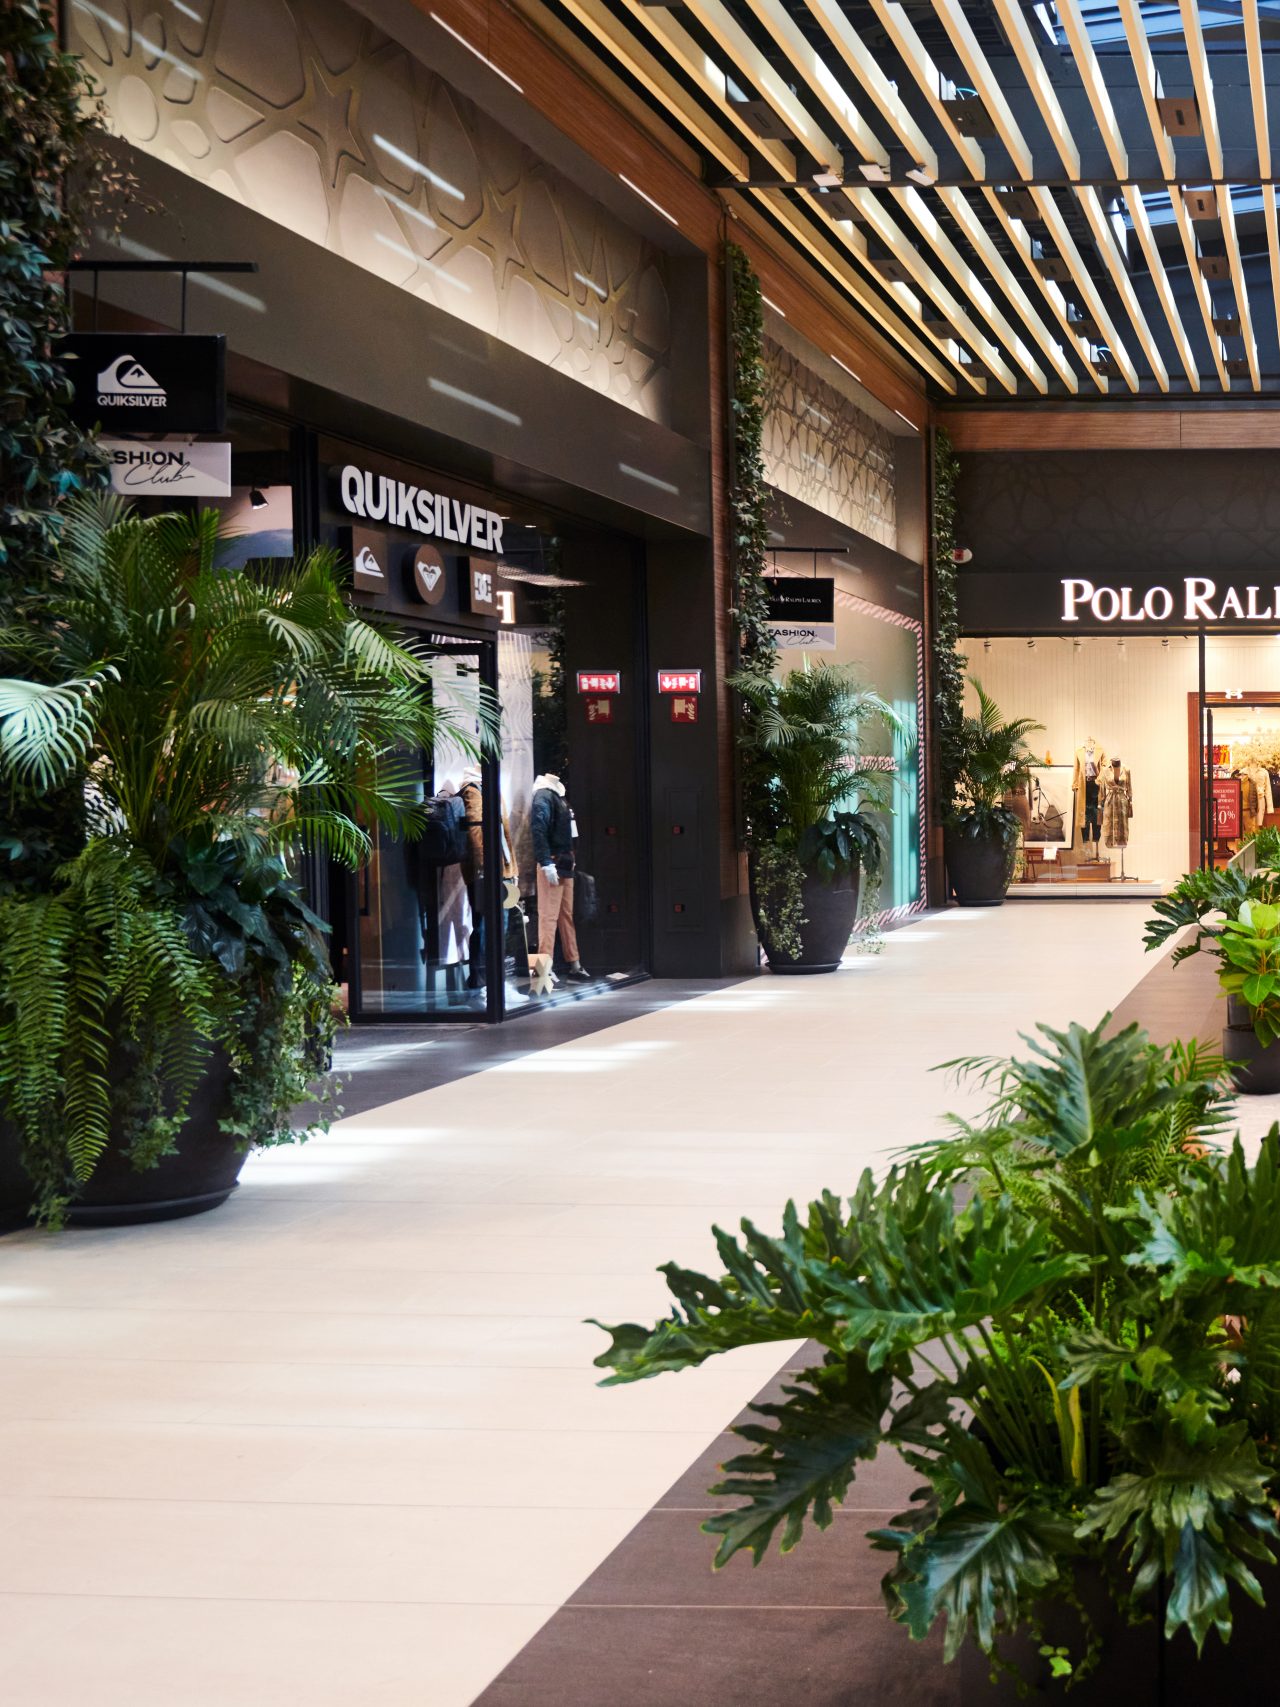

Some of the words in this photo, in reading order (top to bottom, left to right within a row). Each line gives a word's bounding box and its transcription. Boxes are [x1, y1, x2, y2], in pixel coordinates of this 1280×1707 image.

[97, 396, 167, 407] QUIKSILVER
[110, 451, 184, 465] SHION
[124, 461, 195, 485] Club
[341, 465, 504, 554] QUIKSILVER
[1061, 579, 1174, 621] POLO
